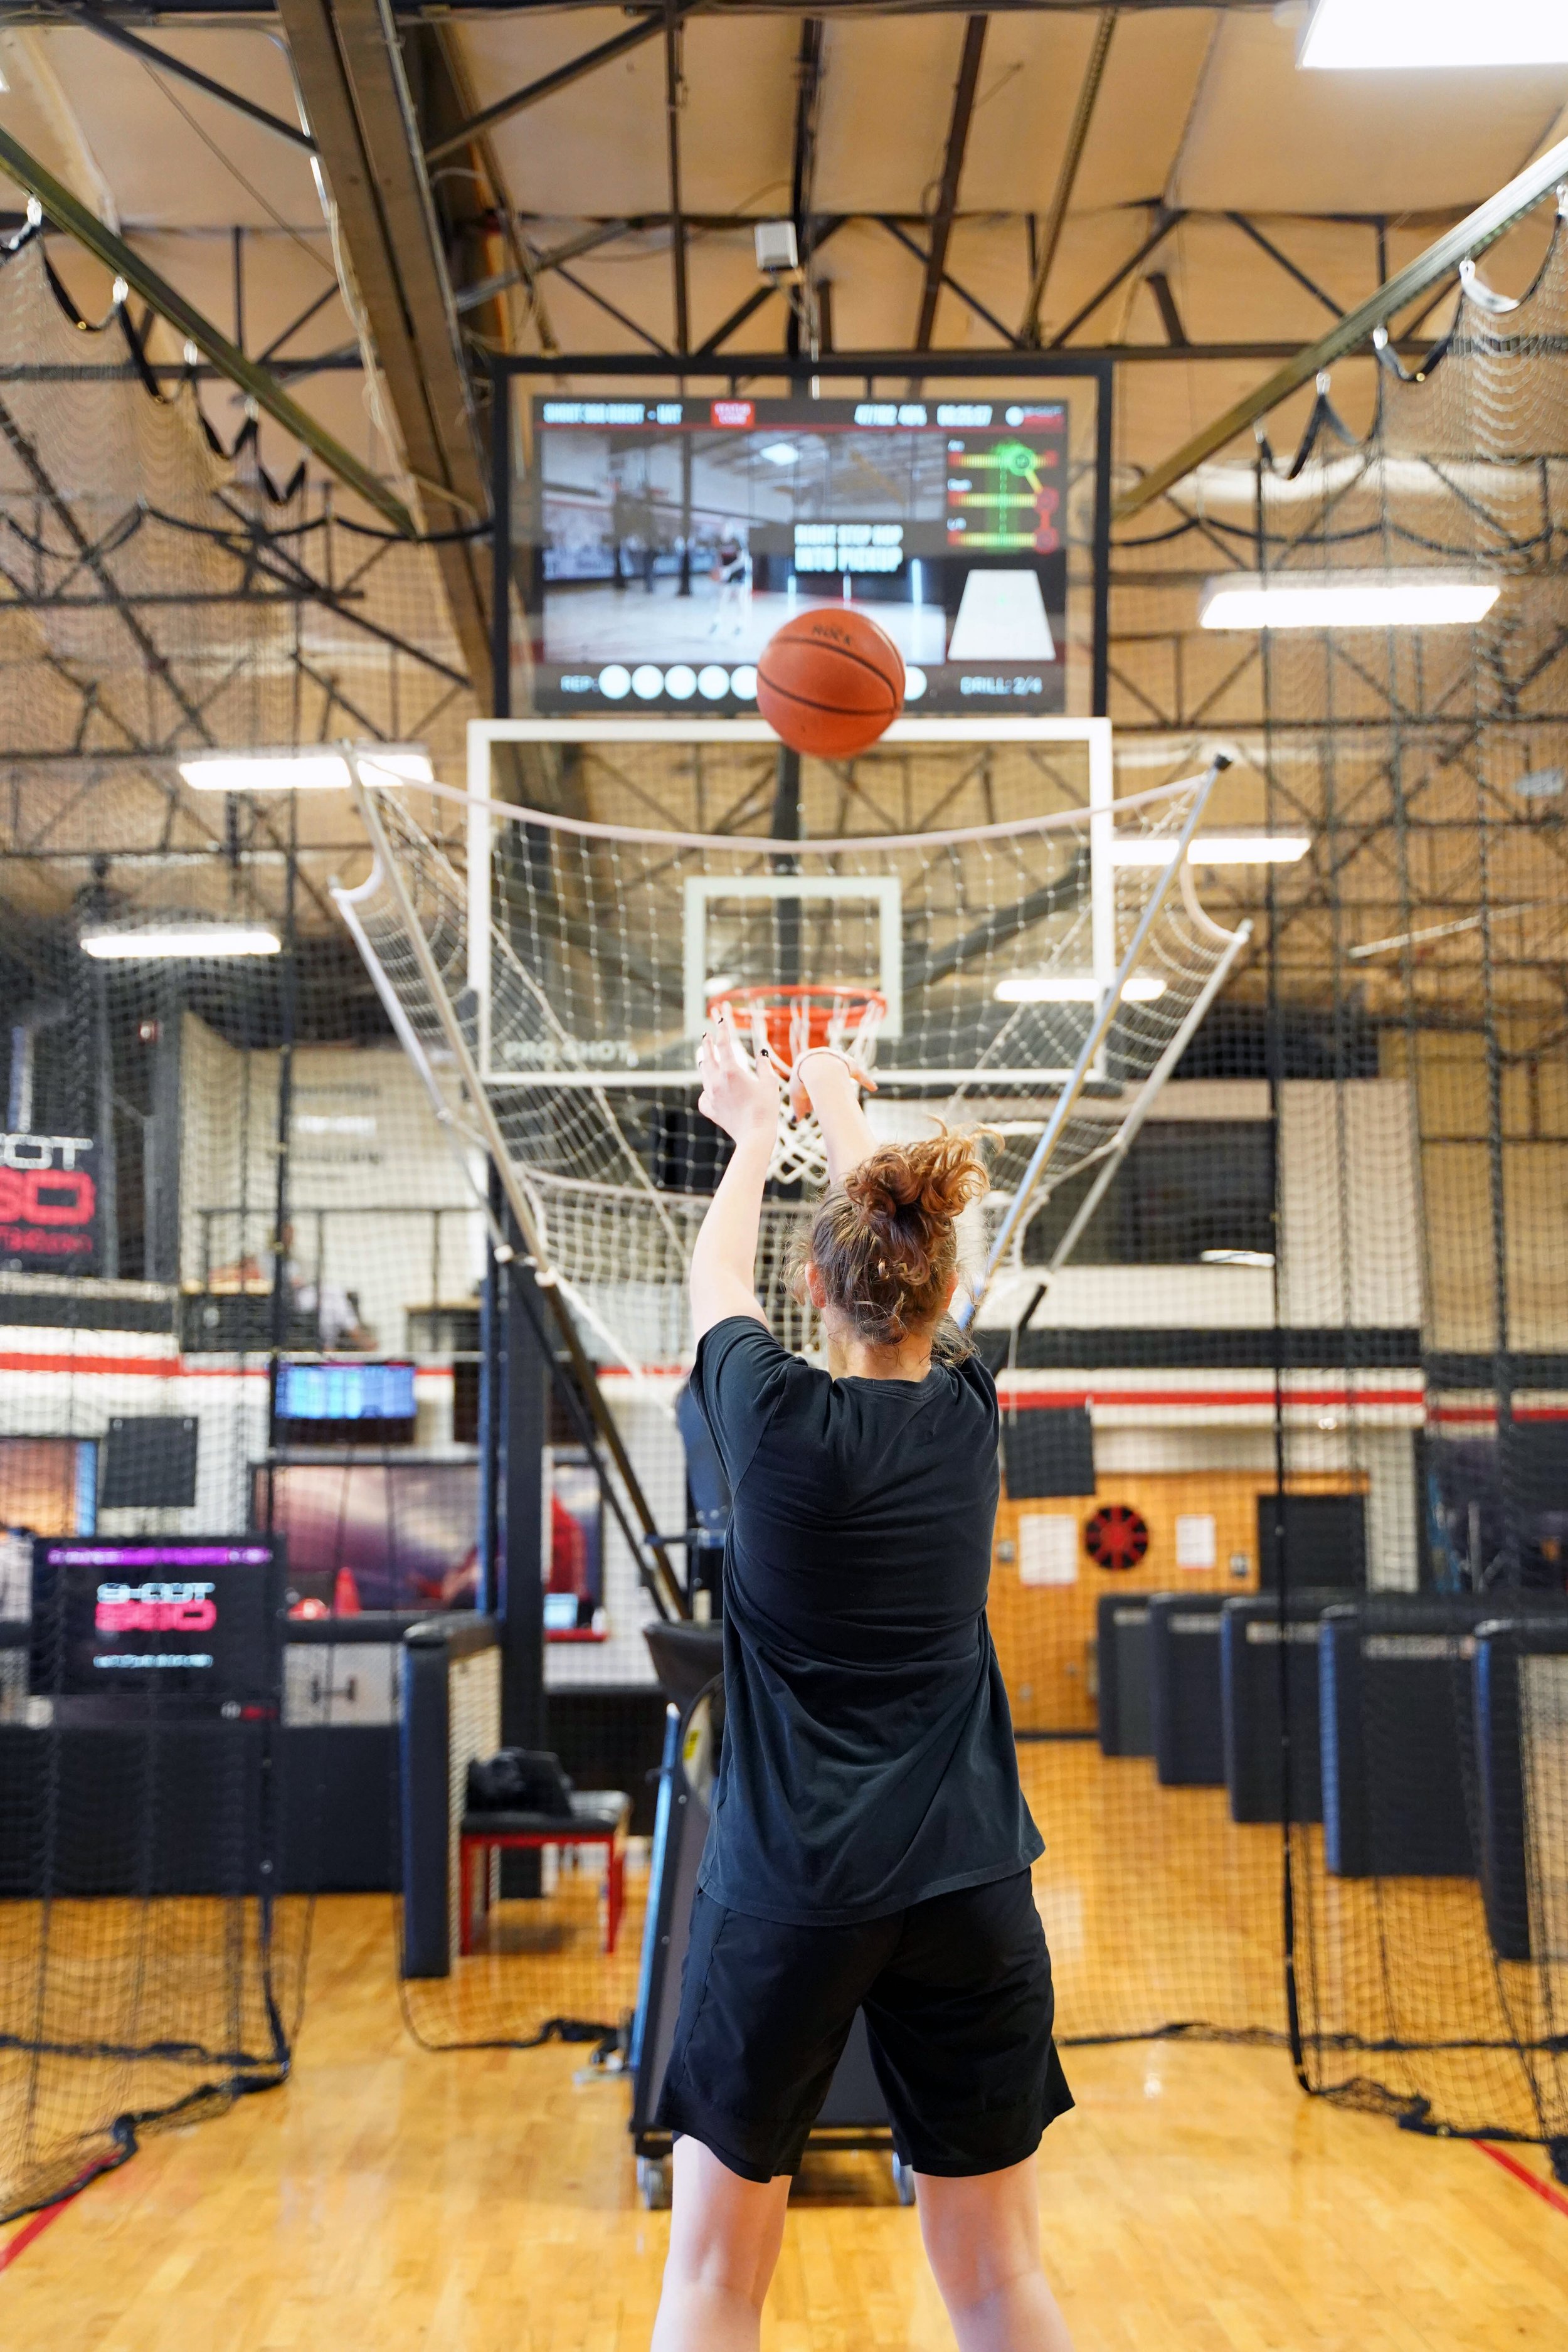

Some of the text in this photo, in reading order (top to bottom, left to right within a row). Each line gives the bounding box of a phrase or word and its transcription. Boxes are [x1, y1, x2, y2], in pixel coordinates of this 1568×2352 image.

[795, 546, 903, 573] INTO PICKUP
[960, 675, 1012, 694] DRILL:
